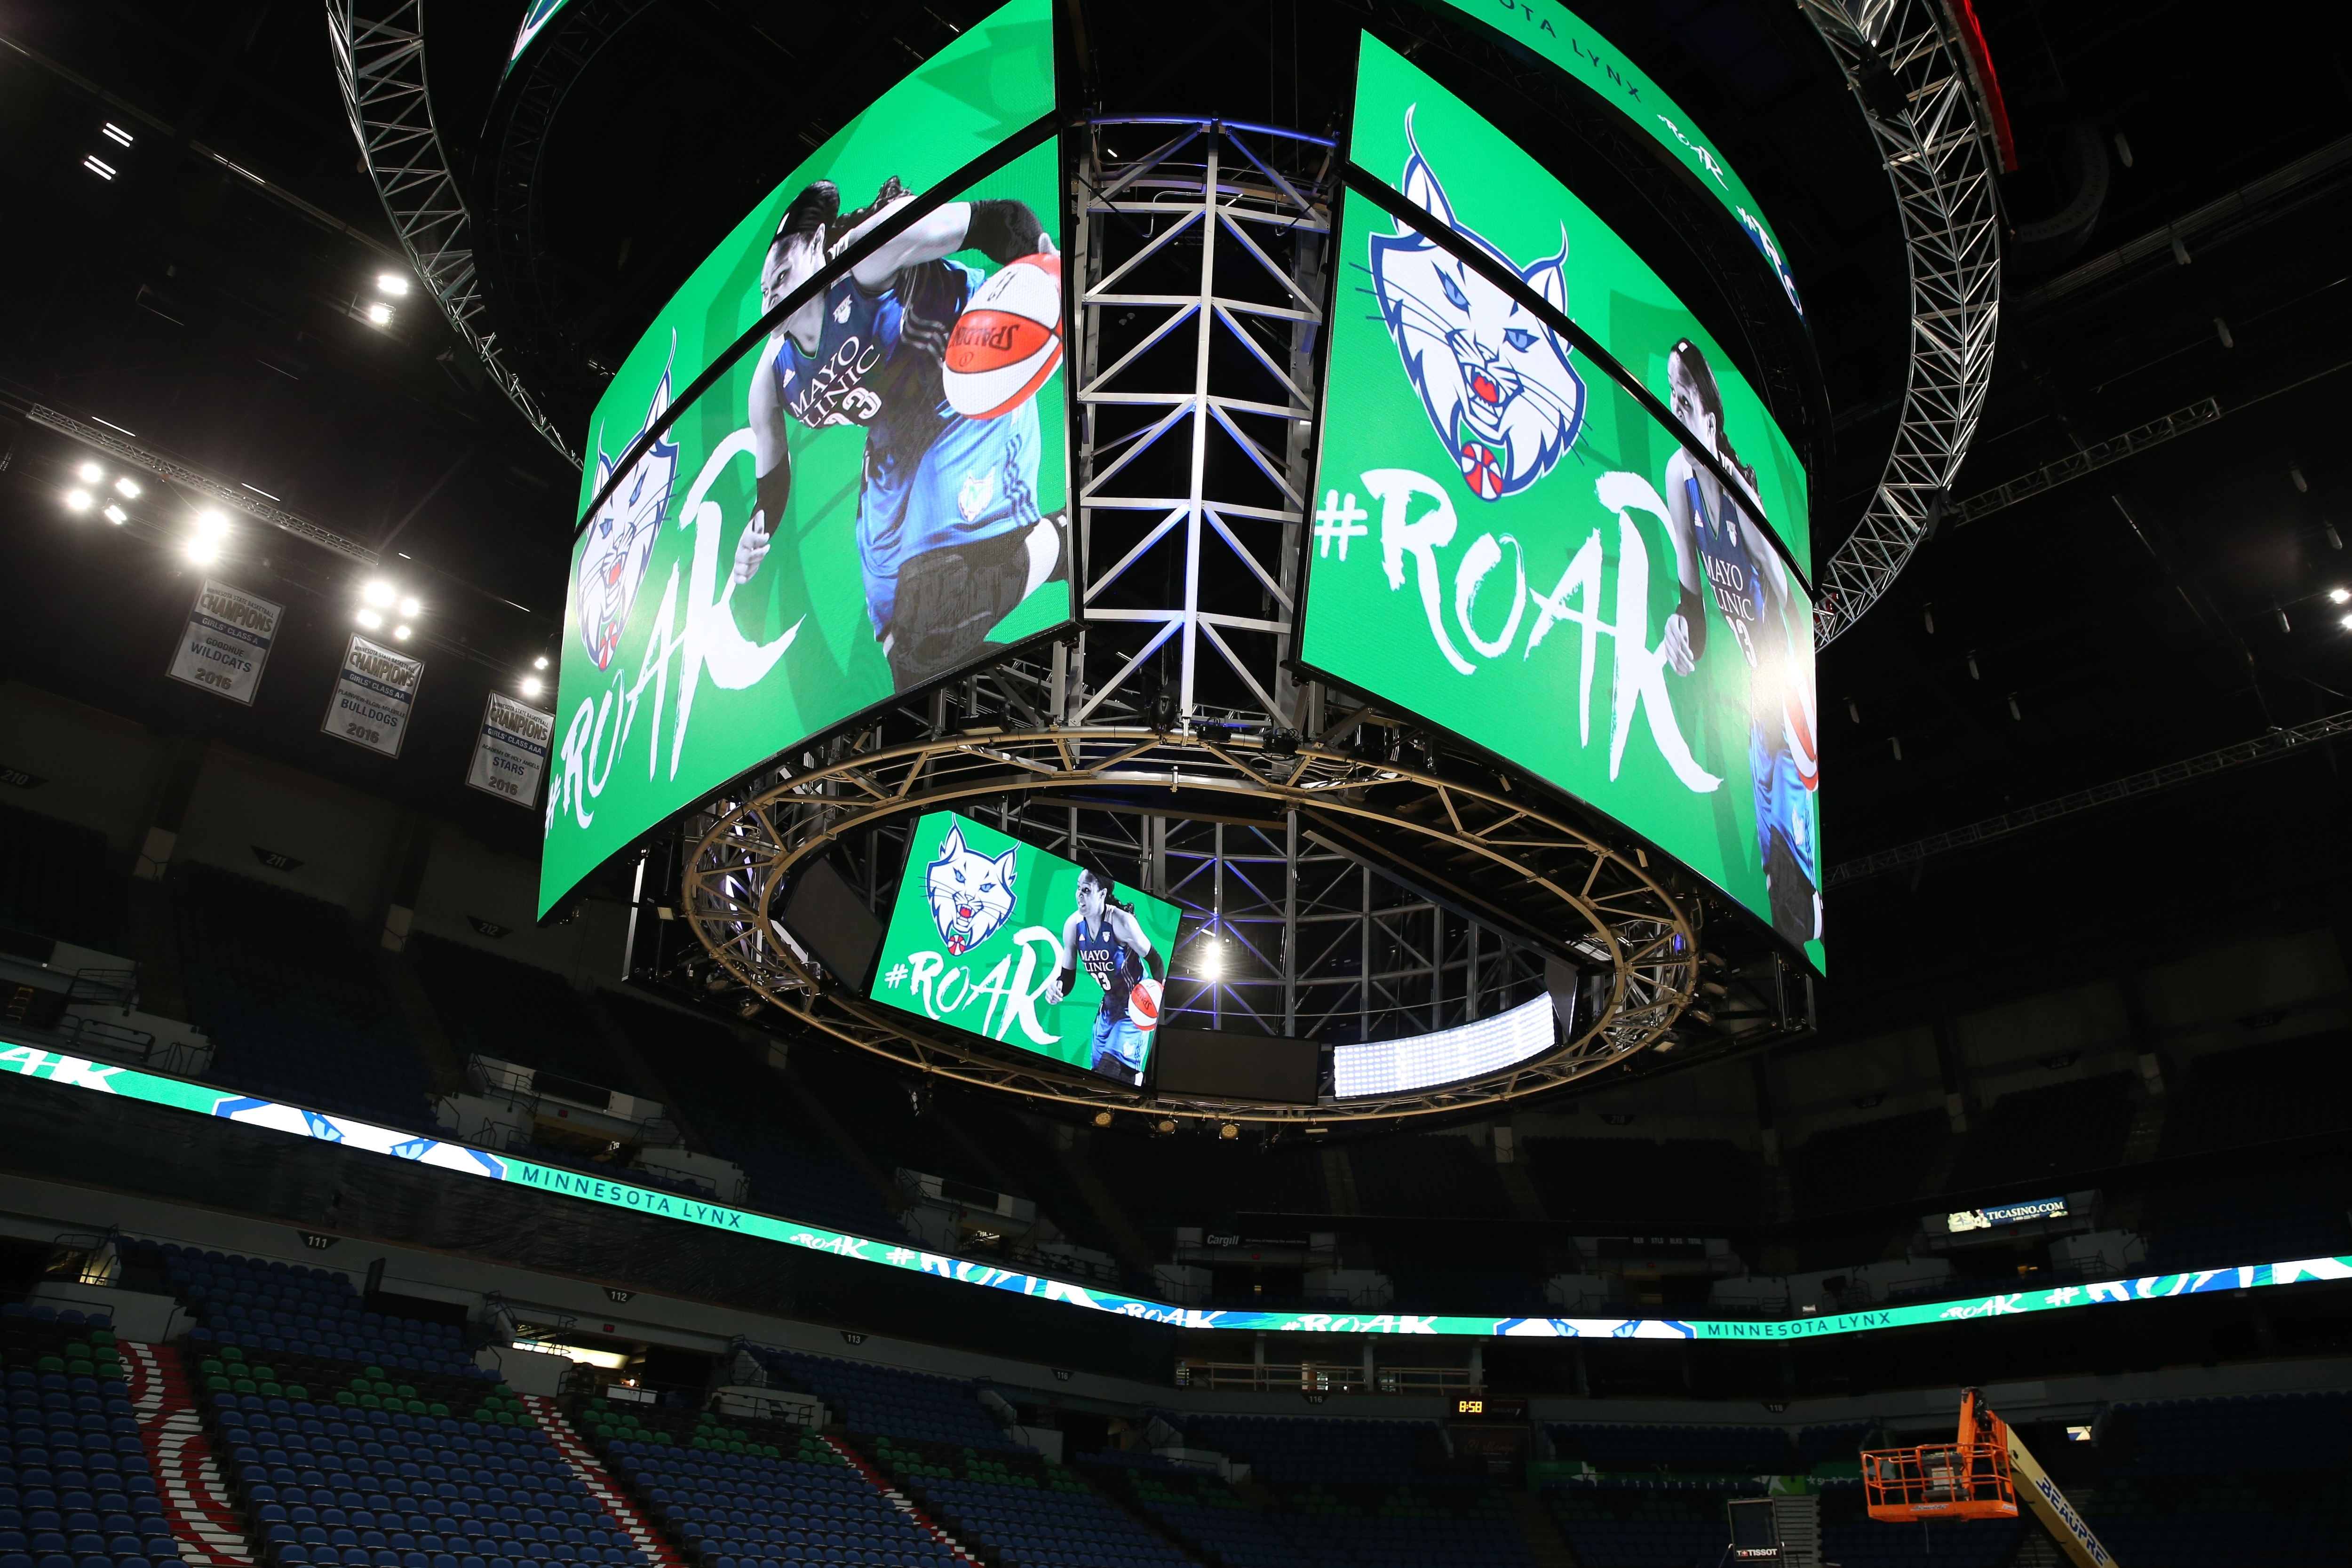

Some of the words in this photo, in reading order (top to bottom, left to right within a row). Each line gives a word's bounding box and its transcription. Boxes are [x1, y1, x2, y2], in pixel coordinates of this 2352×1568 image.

[1572, 39, 1641, 103] LYNX
[790, 336, 860, 417] MAYO
[799, 344, 881, 429] LINIC
[1701, 551, 1743, 591] MAYO
[200, 594, 273, 632] CHAMPIONS
[207, 588, 232, 599] MINNESOTA
[233, 596, 248, 605] STATE
[247, 601, 274, 618] BASKETBALL
[1709, 581, 1755, 621] LINIC
[202, 618, 226, 630] GIRLS'
[227, 628, 252, 641] CLASS
[1308, 468, 1723, 794] #ROAR
[191, 642, 252, 673] WILDCATS
[206, 637, 245, 657] GOODHUE
[354, 645, 378, 656] MINNESOTA
[378, 652, 391, 661] STATE
[391, 657, 415, 674] BASKETBALL
[195, 668, 231, 690] 2016
[349, 652, 414, 687] CHAMPIONS
[350, 674, 371, 686] GIRLS'
[372, 683, 393, 696] CLASS
[394, 691, 405, 700] AA
[338, 688, 406, 718] PLAINVIEW-ELGIN-MILLVILLE
[341, 698, 398, 727] BULLDOGS
[494, 702, 515, 712] MINNESOTA
[516, 708, 527, 716] STATE
[526, 713, 548, 728] BASKETBALL
[346, 722, 380, 744] 2016
[489, 707, 548, 741] CHAMPIONS
[487, 728, 507, 739] GIRLS'
[508, 736, 528, 749] CLASS
[528, 745, 541, 754] AAA
[482, 744, 504, 756] ACADEMY
[511, 754, 522, 763] HOLY
[522, 759, 540, 770] ANGELS
[493, 756, 525, 776] STARS
[0, 770, 29, 785] 210
[489, 776, 519, 796] 2016
[266, 854, 287, 868] 211
[479, 923, 499, 936] 212
[1080, 949, 1110, 961] MAYO
[1082, 962, 1114, 972] LINIC
[885, 925, 1064, 1045] #ROAR
[522, 1166, 670, 1212] MINNESOTA
[683, 1203, 741, 1228] LYNX
[1986, 1201, 2064, 1221] TICASINO.COM
[308, 1236, 327, 1248] 111
[1207, 1234, 1240, 1247] Cargill
[611, 1290, 627, 1302] 112
[1708, 1321, 1828, 1336] MINNESOTA
[1838, 1311, 1891, 1329] LYNX
[847, 1334, 862, 1344] 113
[1057, 1371, 1068, 1380] 116
[1309, 1395, 1323, 1404] 116
[1459, 1401, 1483, 1413] 8:58
[1769, 1404, 1784, 1412] 118
[2035, 1476, 2109, 1567] BEAUPRE
